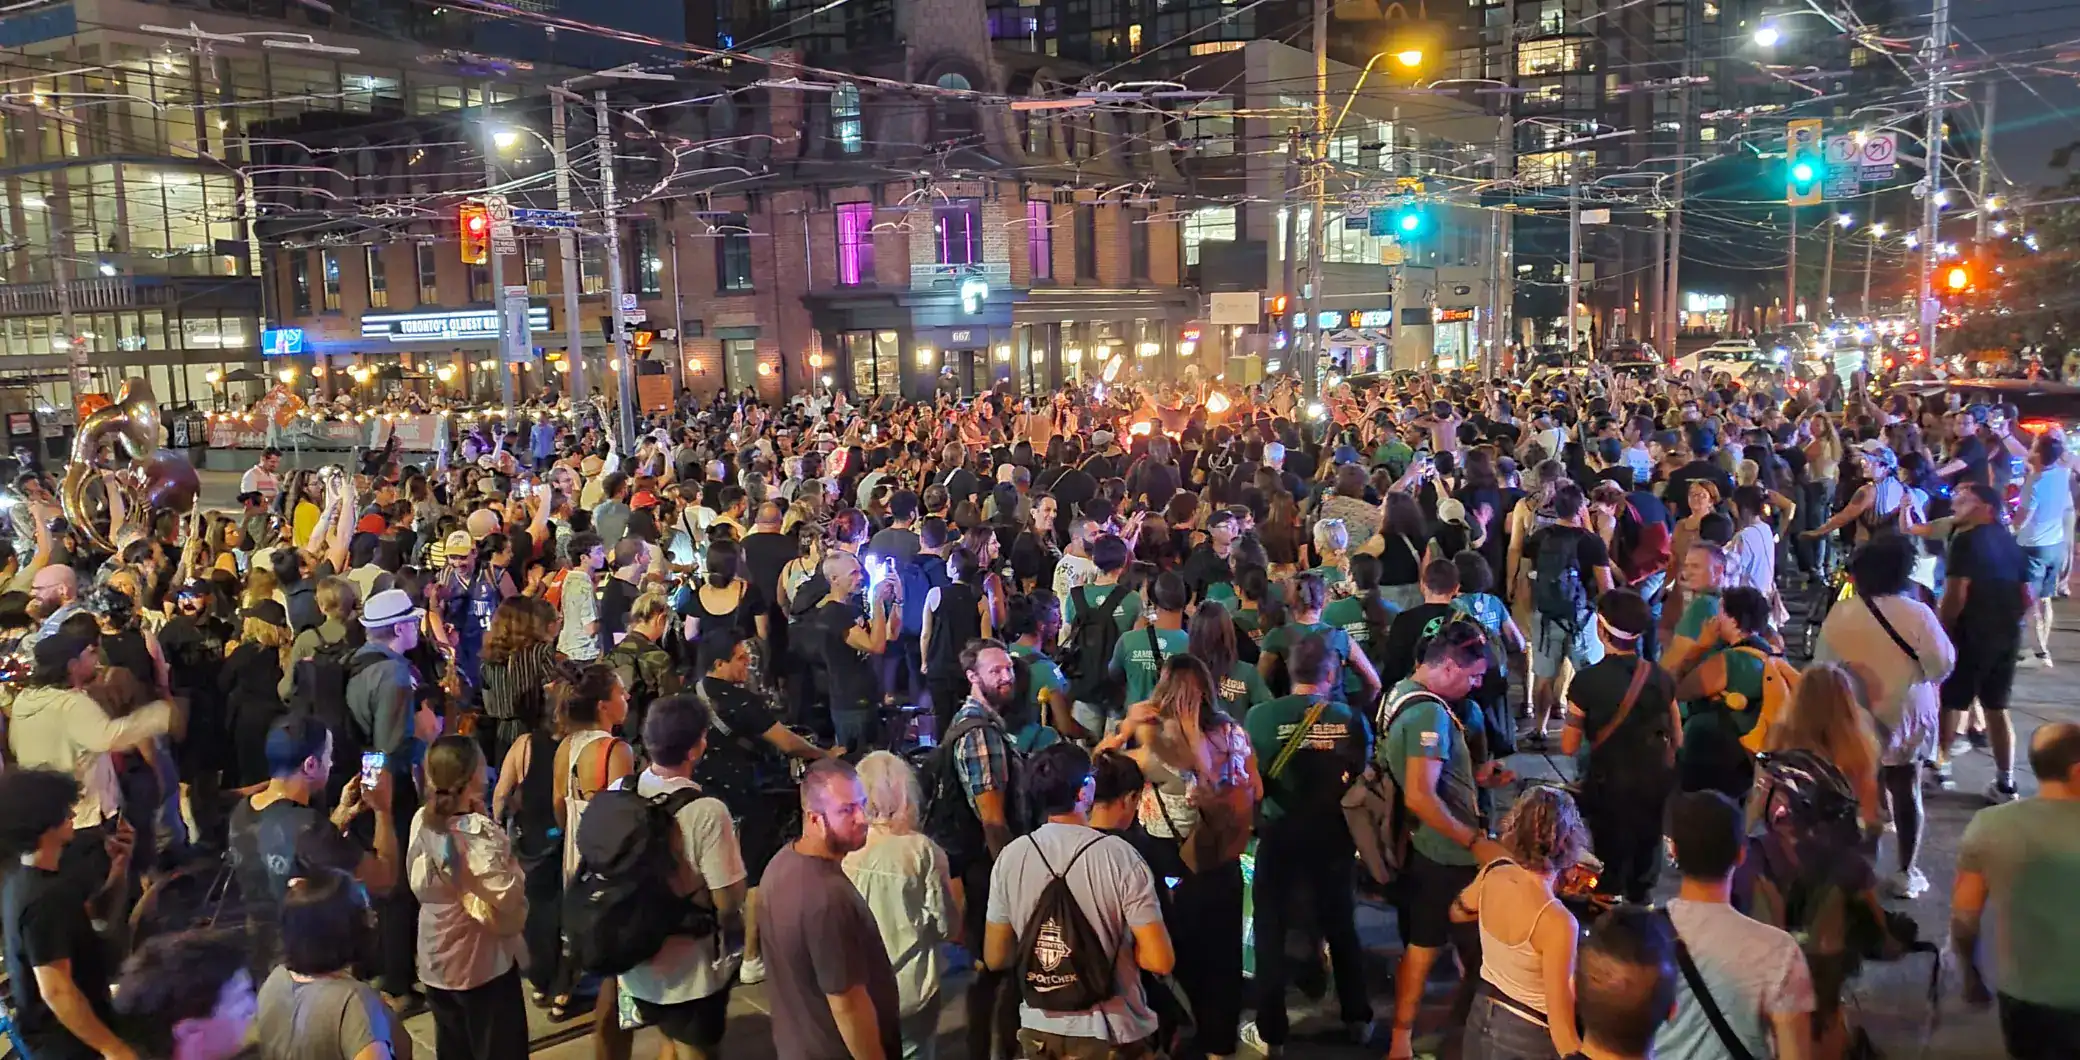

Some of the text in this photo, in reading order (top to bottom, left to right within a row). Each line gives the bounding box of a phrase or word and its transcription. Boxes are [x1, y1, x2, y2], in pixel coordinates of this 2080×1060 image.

[401, 319, 447, 333] TORONTO'S
[450, 318, 482, 331] OLDEST
[952, 331, 970, 342] 667
[1132, 650, 1155, 658] SAMB
